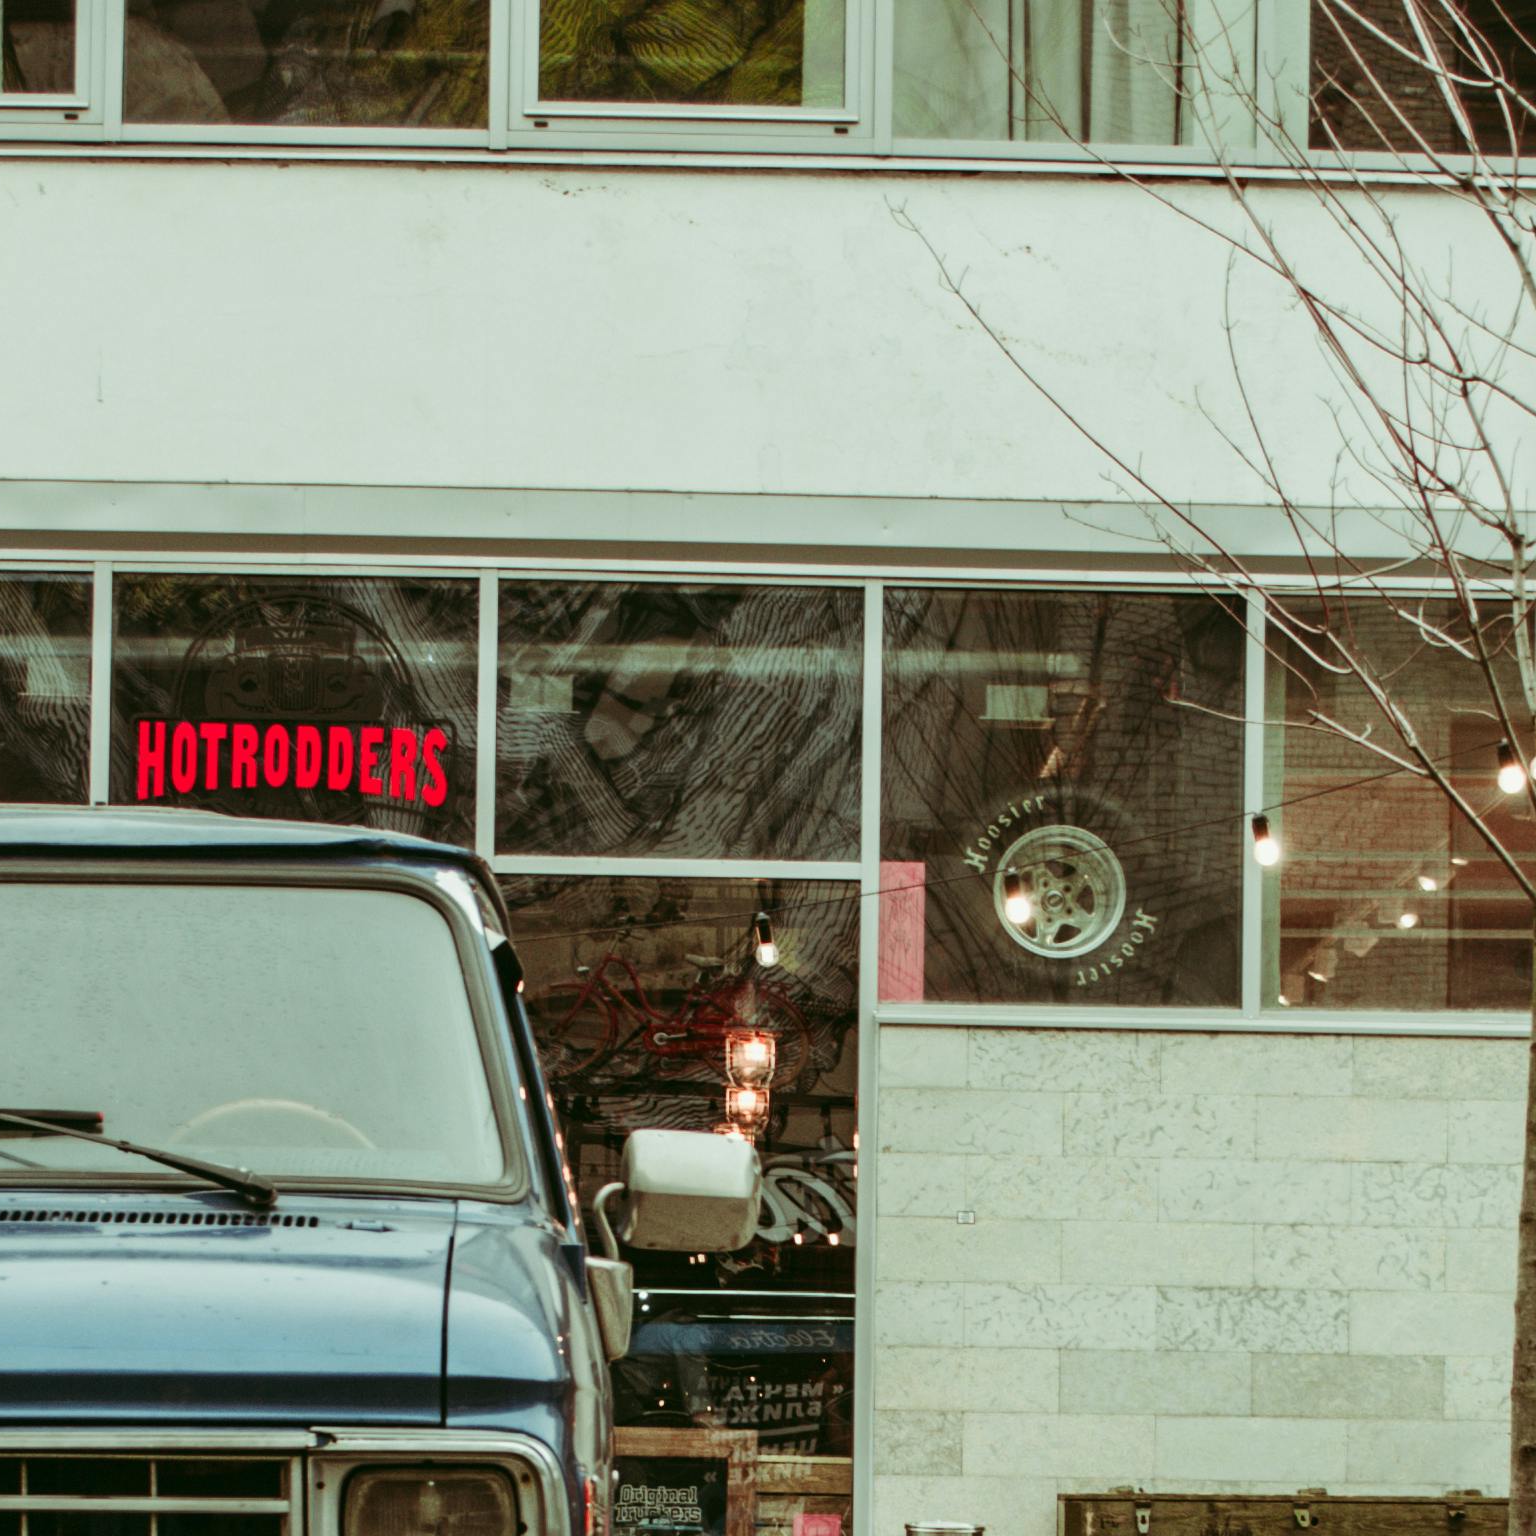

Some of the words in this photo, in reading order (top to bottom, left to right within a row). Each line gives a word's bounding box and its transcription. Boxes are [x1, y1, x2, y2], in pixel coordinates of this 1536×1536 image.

[137, 720, 448, 807] HOTRODDERS
[964, 794, 1046, 875] Hoosier
[1075, 907, 1159, 987] Hoosier
[619, 1484, 699, 1505] Original
